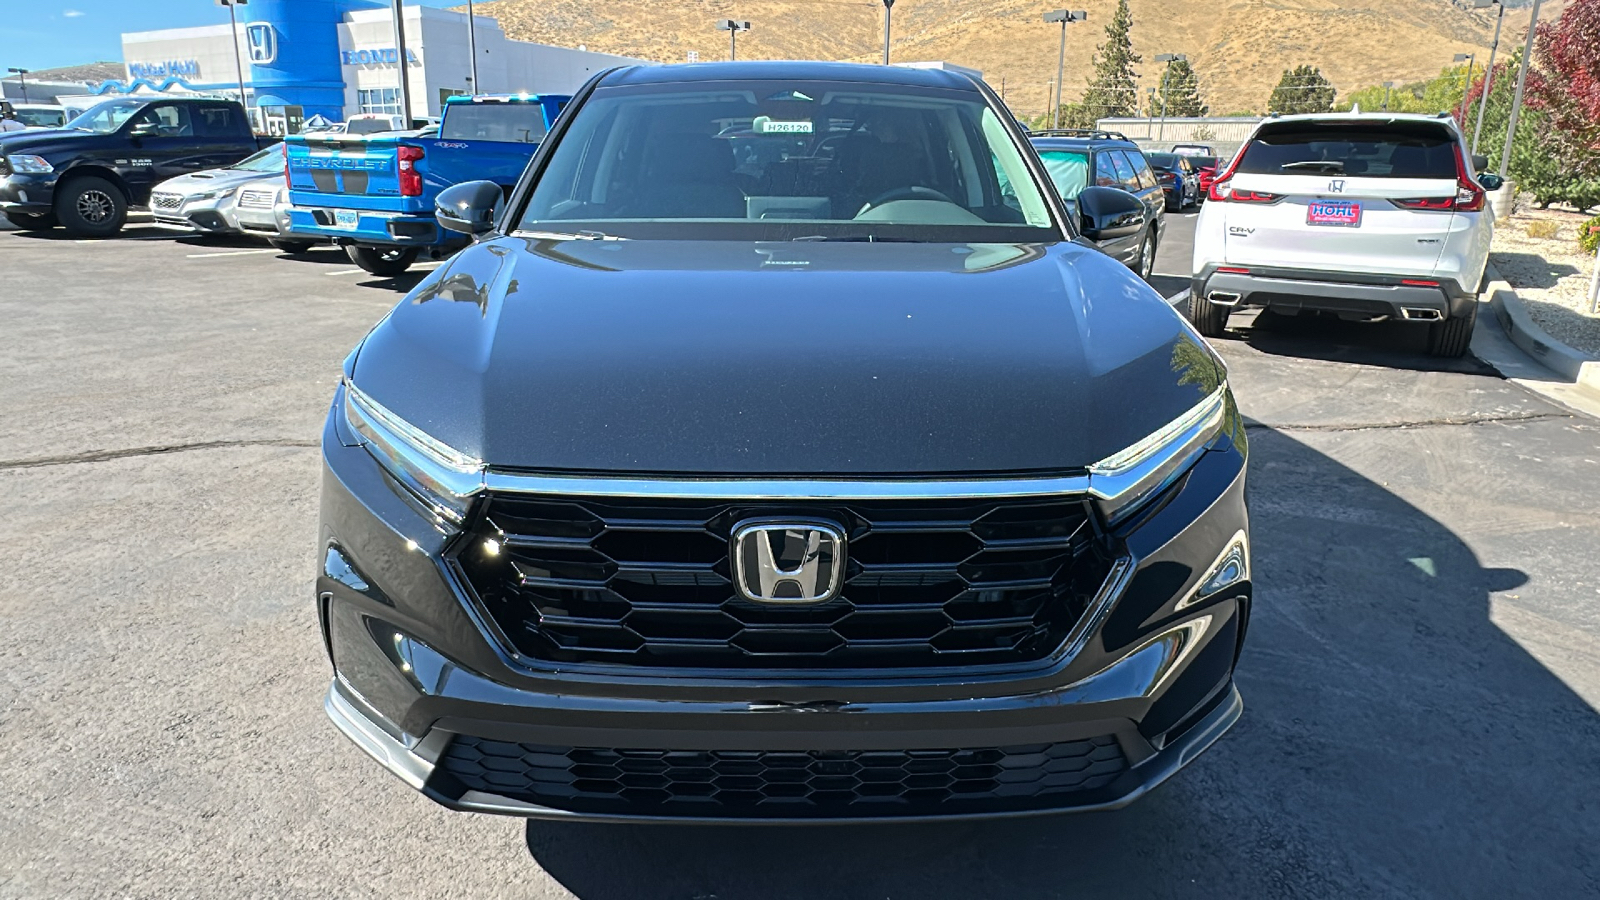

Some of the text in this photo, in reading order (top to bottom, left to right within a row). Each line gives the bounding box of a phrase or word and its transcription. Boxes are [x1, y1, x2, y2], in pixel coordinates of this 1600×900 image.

[342, 48, 415, 65] HONDA
[768, 124, 809, 132] H26120
[291, 158, 388, 170] CHEVROLET
[1312, 204, 1354, 217] HOHL
[1229, 226, 1256, 234] CR-V
